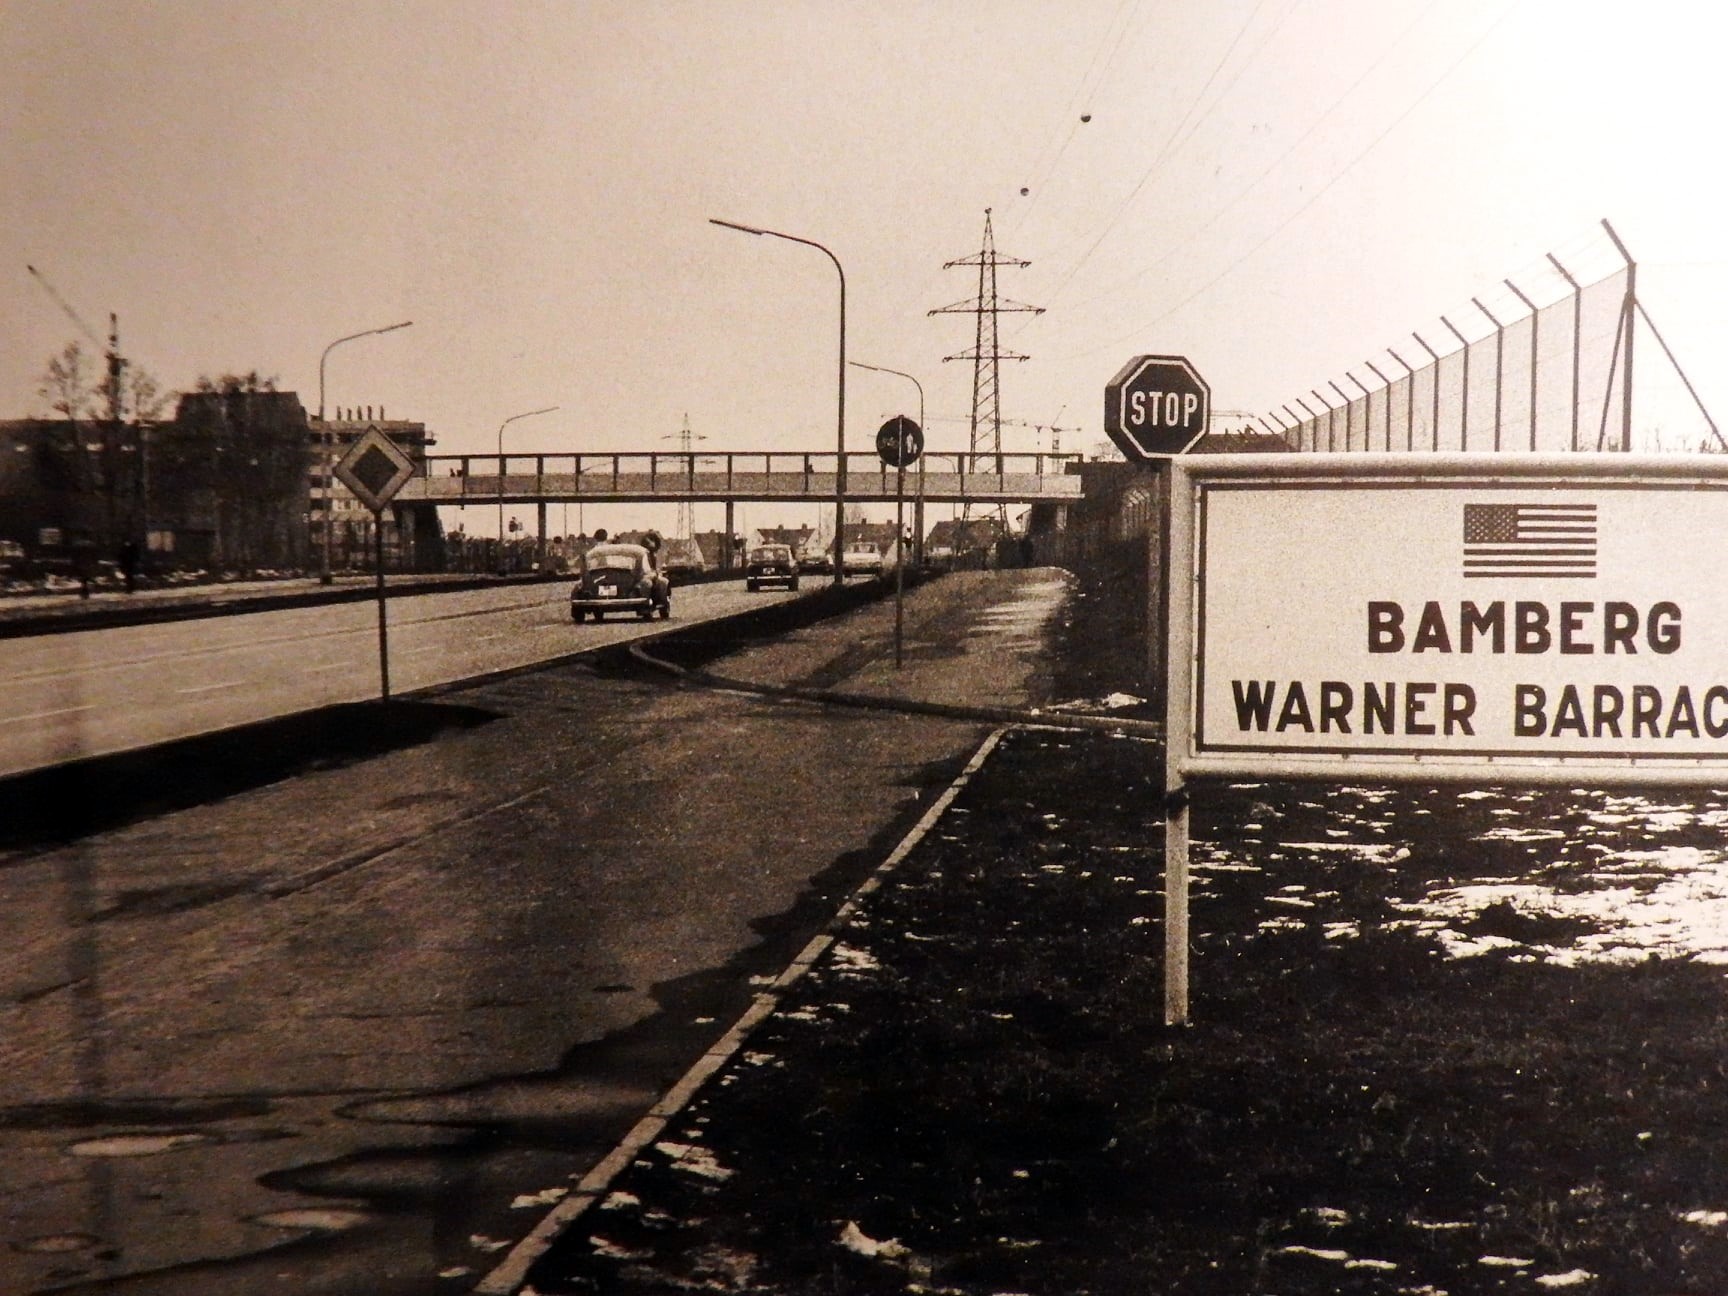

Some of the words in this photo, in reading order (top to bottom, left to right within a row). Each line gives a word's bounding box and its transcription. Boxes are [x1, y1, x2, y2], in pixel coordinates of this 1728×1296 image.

[1130, 390, 1198, 428] STOP
[1367, 601, 1681, 654] BAMBERG
[1231, 680, 1476, 736] WARNER
[1514, 684, 1728, 739] BARRAC
